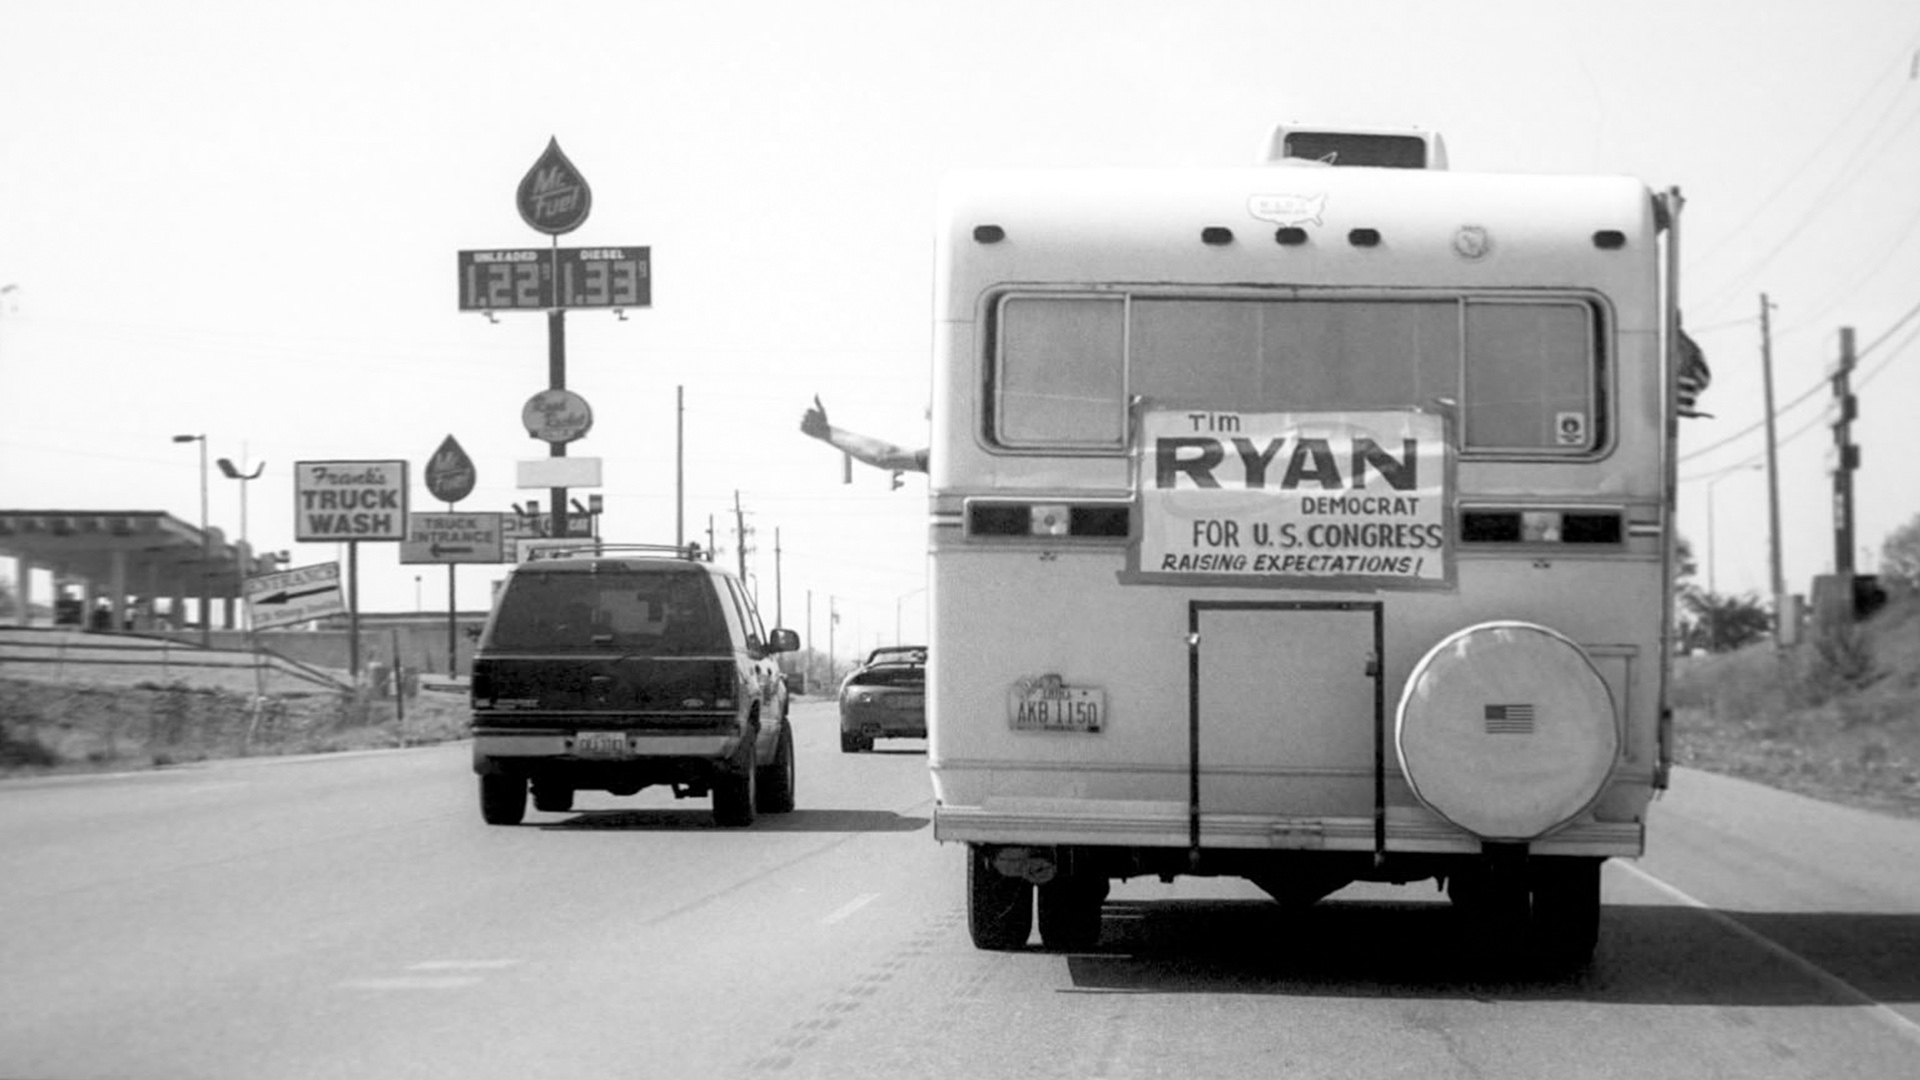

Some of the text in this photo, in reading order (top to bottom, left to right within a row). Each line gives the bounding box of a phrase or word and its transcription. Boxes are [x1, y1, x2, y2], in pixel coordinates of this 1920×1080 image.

[531, 186, 580, 219] Fuel
[474, 252, 537, 263] UNLEADED
[580, 250, 625, 260] DIESEL
[1156, 437, 1418, 491] RYAN
[311, 466, 386, 485] Frank's
[302, 489, 399, 510] TRUCK
[1302, 496, 1420, 516] DEMOCRAT
[307, 513, 392, 534] WASH
[425, 518, 478, 529] TRUCK
[1192, 519, 1240, 548] FOR
[1307, 523, 1443, 549] CONGRESS
[1161, 553, 1424, 577] RAISING EXPECTATIONS!
[1017, 700, 1098, 725] AKB 1150
